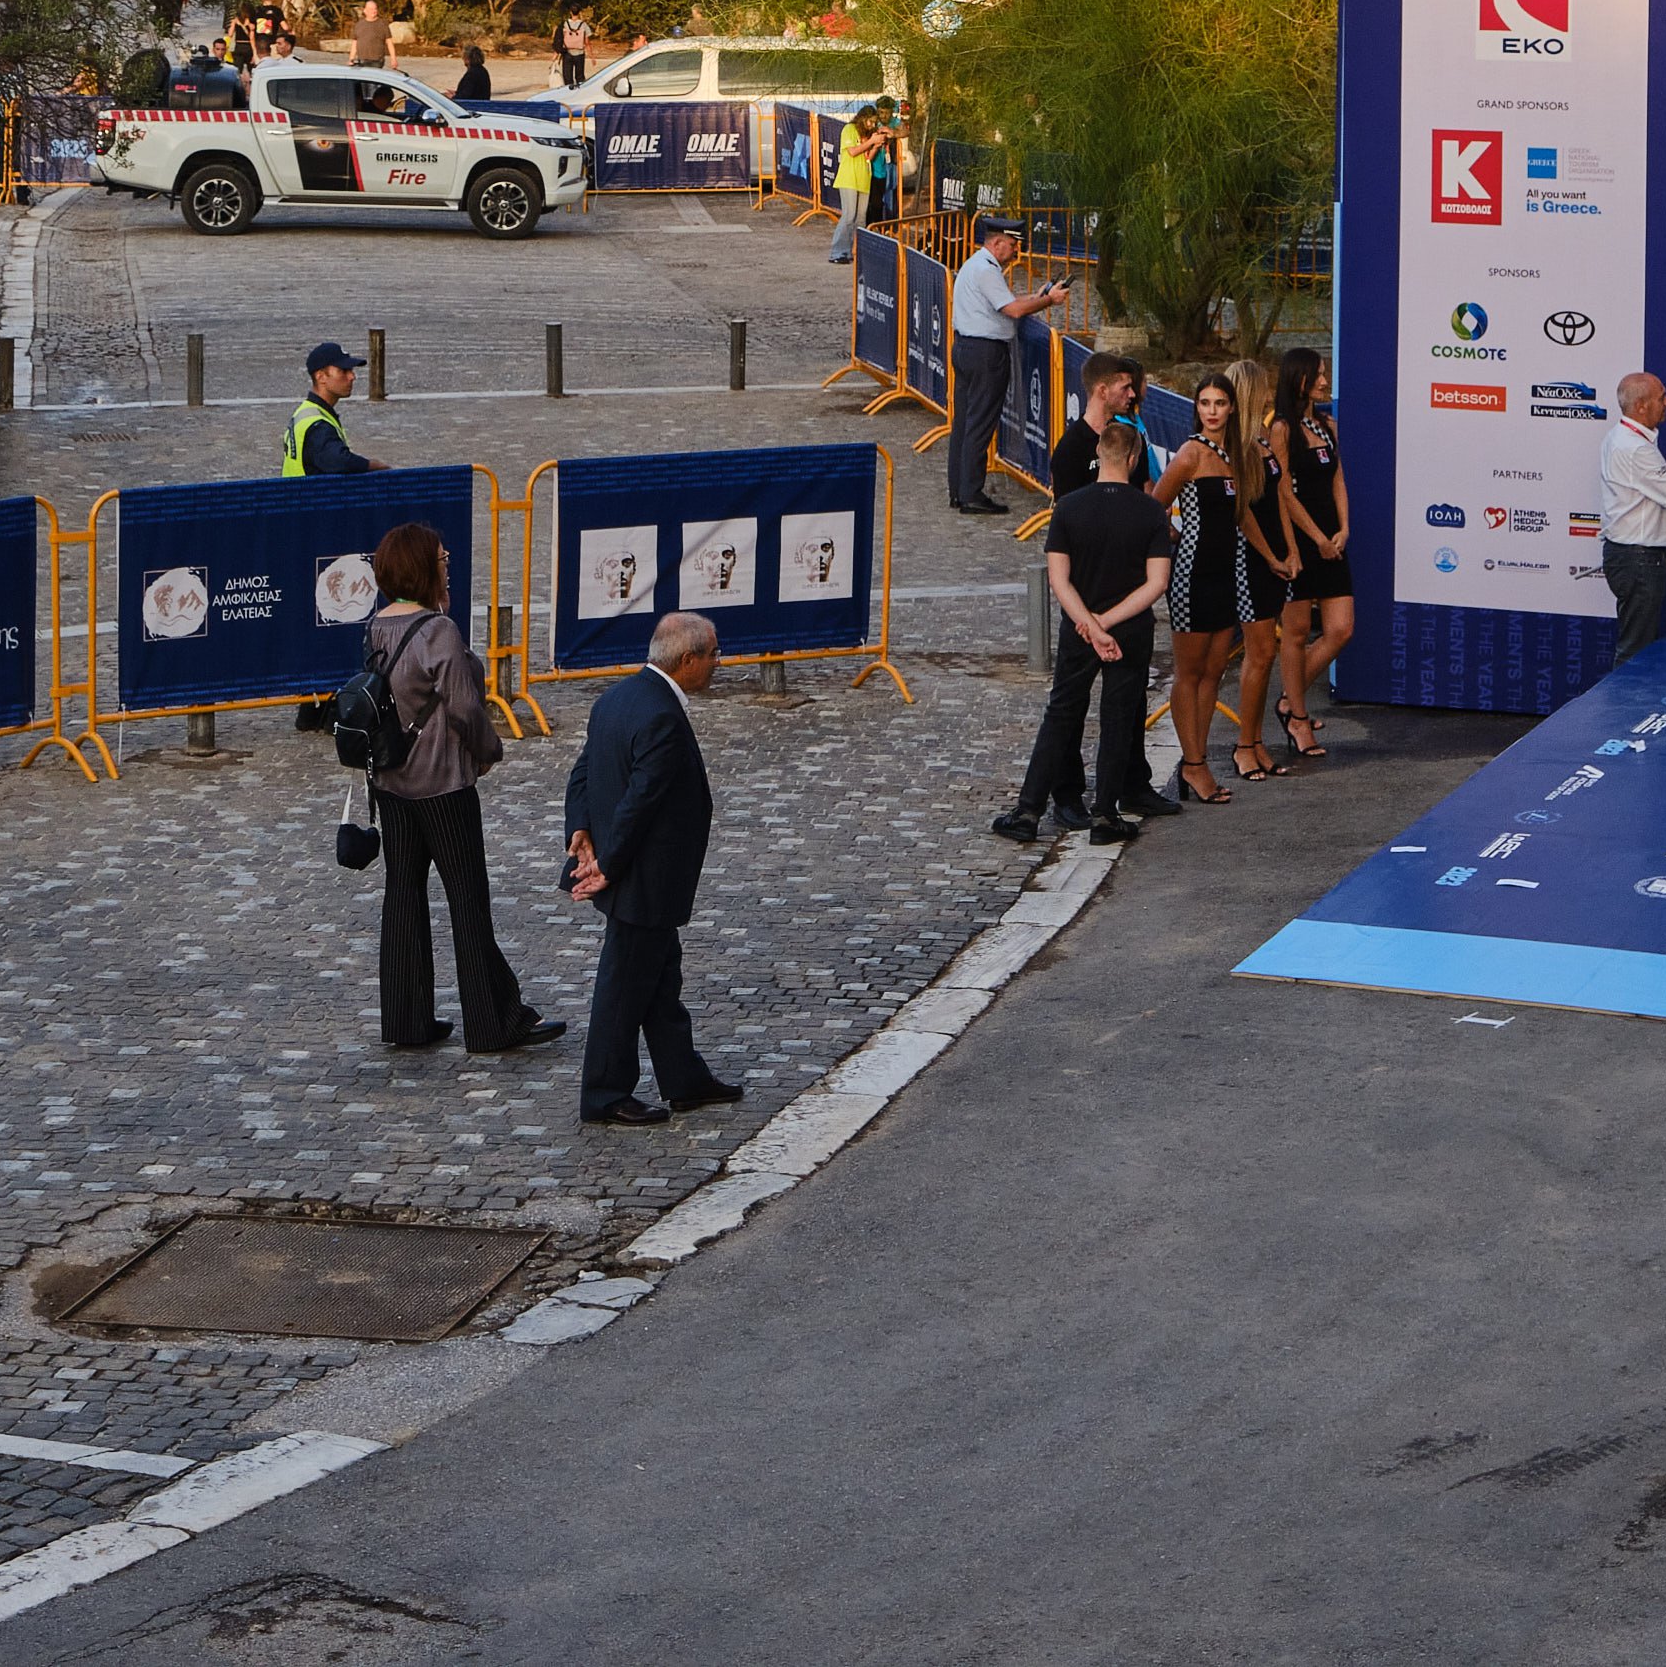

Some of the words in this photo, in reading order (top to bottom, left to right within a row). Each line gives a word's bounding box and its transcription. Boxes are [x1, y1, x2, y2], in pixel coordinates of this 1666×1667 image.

[1502, 38, 1564, 55] EKO
[1477, 100, 1514, 110] GRAND
[1517, 100, 1569, 111] SPONSORS
[608, 135, 660, 153] OMAE
[686, 134, 739, 152] OMAE
[376, 152, 438, 163] GRGENESIS
[387, 169, 427, 185] Fire
[942, 177, 966, 200] OMAE
[1526, 189, 1539, 198] All
[1541, 191, 1559, 200] you
[1562, 191, 1586, 200] want
[1526, 199, 1539, 212] is
[1543, 200, 1602, 214] Greece.
[1488, 268, 1541, 278] SPONSORS
[1431, 345, 1507, 361] COSMOTE
[1434, 389, 1498, 406] betsson
[1493, 470, 1543, 481] PARTNERS
[1513, 509, 1546, 518] ATHENS
[1513, 518, 1550, 526] MEDICAL
[1513, 525, 1544, 533] GROUP
[225, 575, 269, 590] ΔΗΜΟΣ
[212, 589, 282, 607] ΑΜΦΙΚΛΕΙΑΣ
[222, 606, 272, 621] ΕΛΑΤΕΙΑΣ
